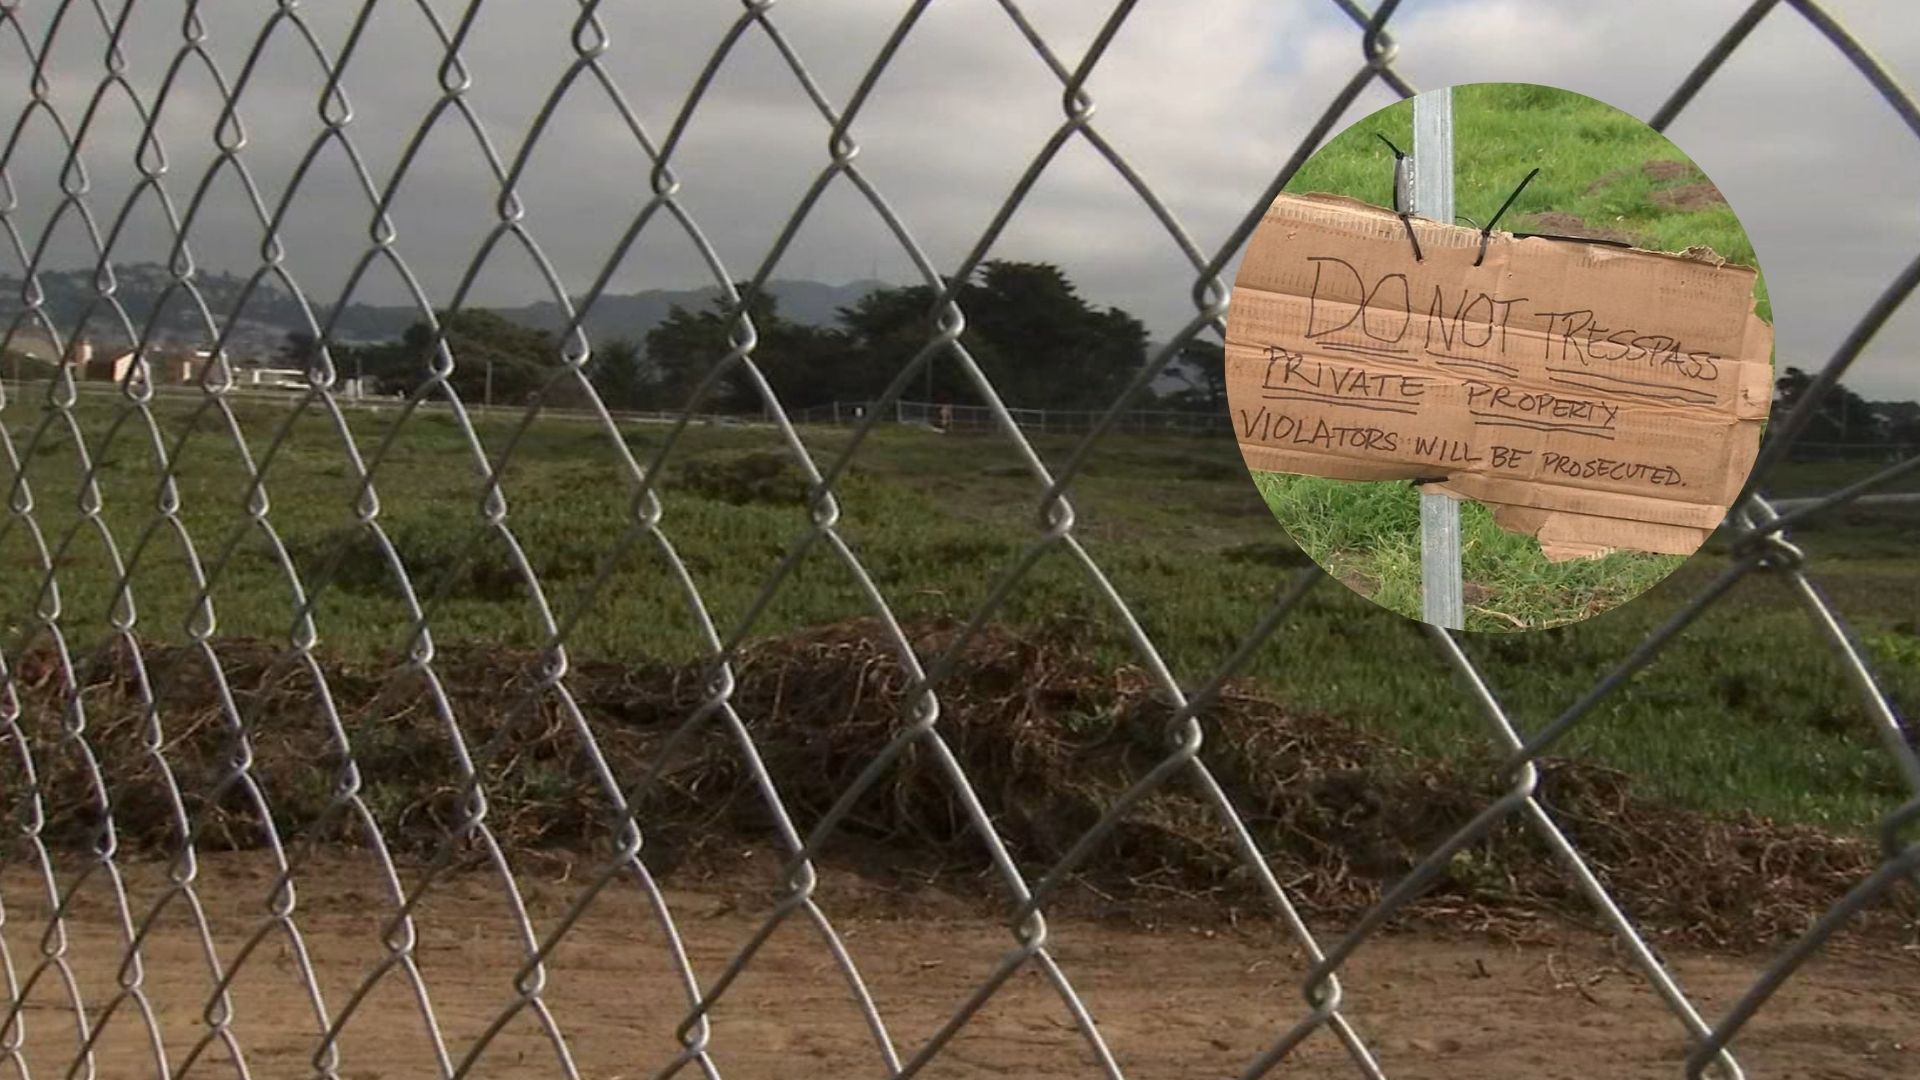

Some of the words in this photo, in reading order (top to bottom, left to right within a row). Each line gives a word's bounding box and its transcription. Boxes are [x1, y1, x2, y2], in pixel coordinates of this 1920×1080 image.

[1304, 256, 1410, 344] DO
[1424, 284, 1529, 353] NOT
[1534, 309, 1721, 380] TRESSPASS
[1262, 345, 1436, 397] PRIVATE
[1461, 379, 1619, 428] PROPERTY
[1240, 406, 1399, 452] VIOLATORS
[1415, 436, 1482, 462] WILL
[1490, 445, 1532, 468] BE
